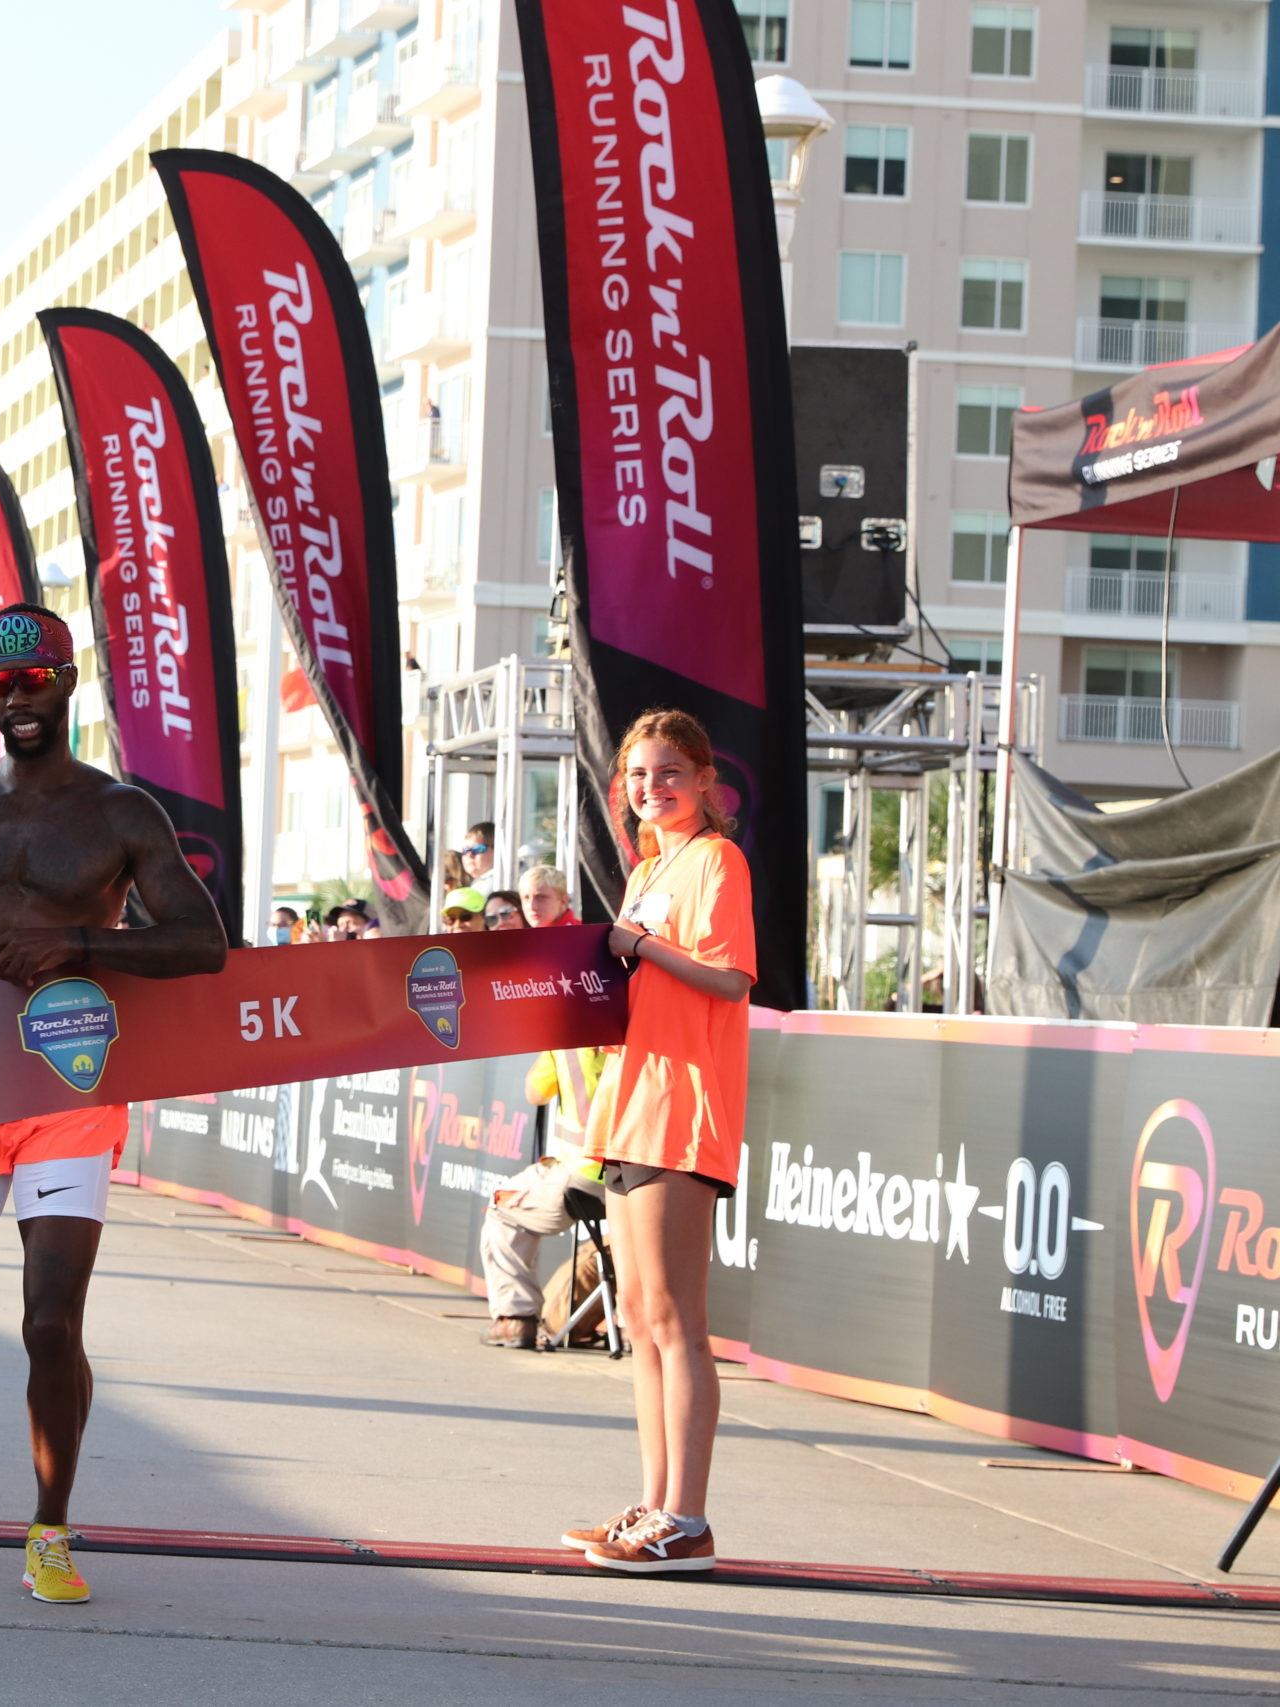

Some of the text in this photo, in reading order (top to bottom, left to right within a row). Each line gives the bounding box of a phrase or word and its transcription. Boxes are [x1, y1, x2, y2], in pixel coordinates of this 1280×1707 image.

[583, 53, 647, 527] RUNNING SERIES
[235, 304, 283, 485] RUNNING
[102, 434, 150, 709] RUNNING SERIES
[491, 978, 557, 1000] Heineken
[40, 1024, 105, 1039] RUNNING SERIES
[48, 1038, 106, 1051] VIRGINIA BEACH
[765, 1141, 940, 1243] Heineken
[1000, 1286, 1068, 1322] ALCOHOL FREE
